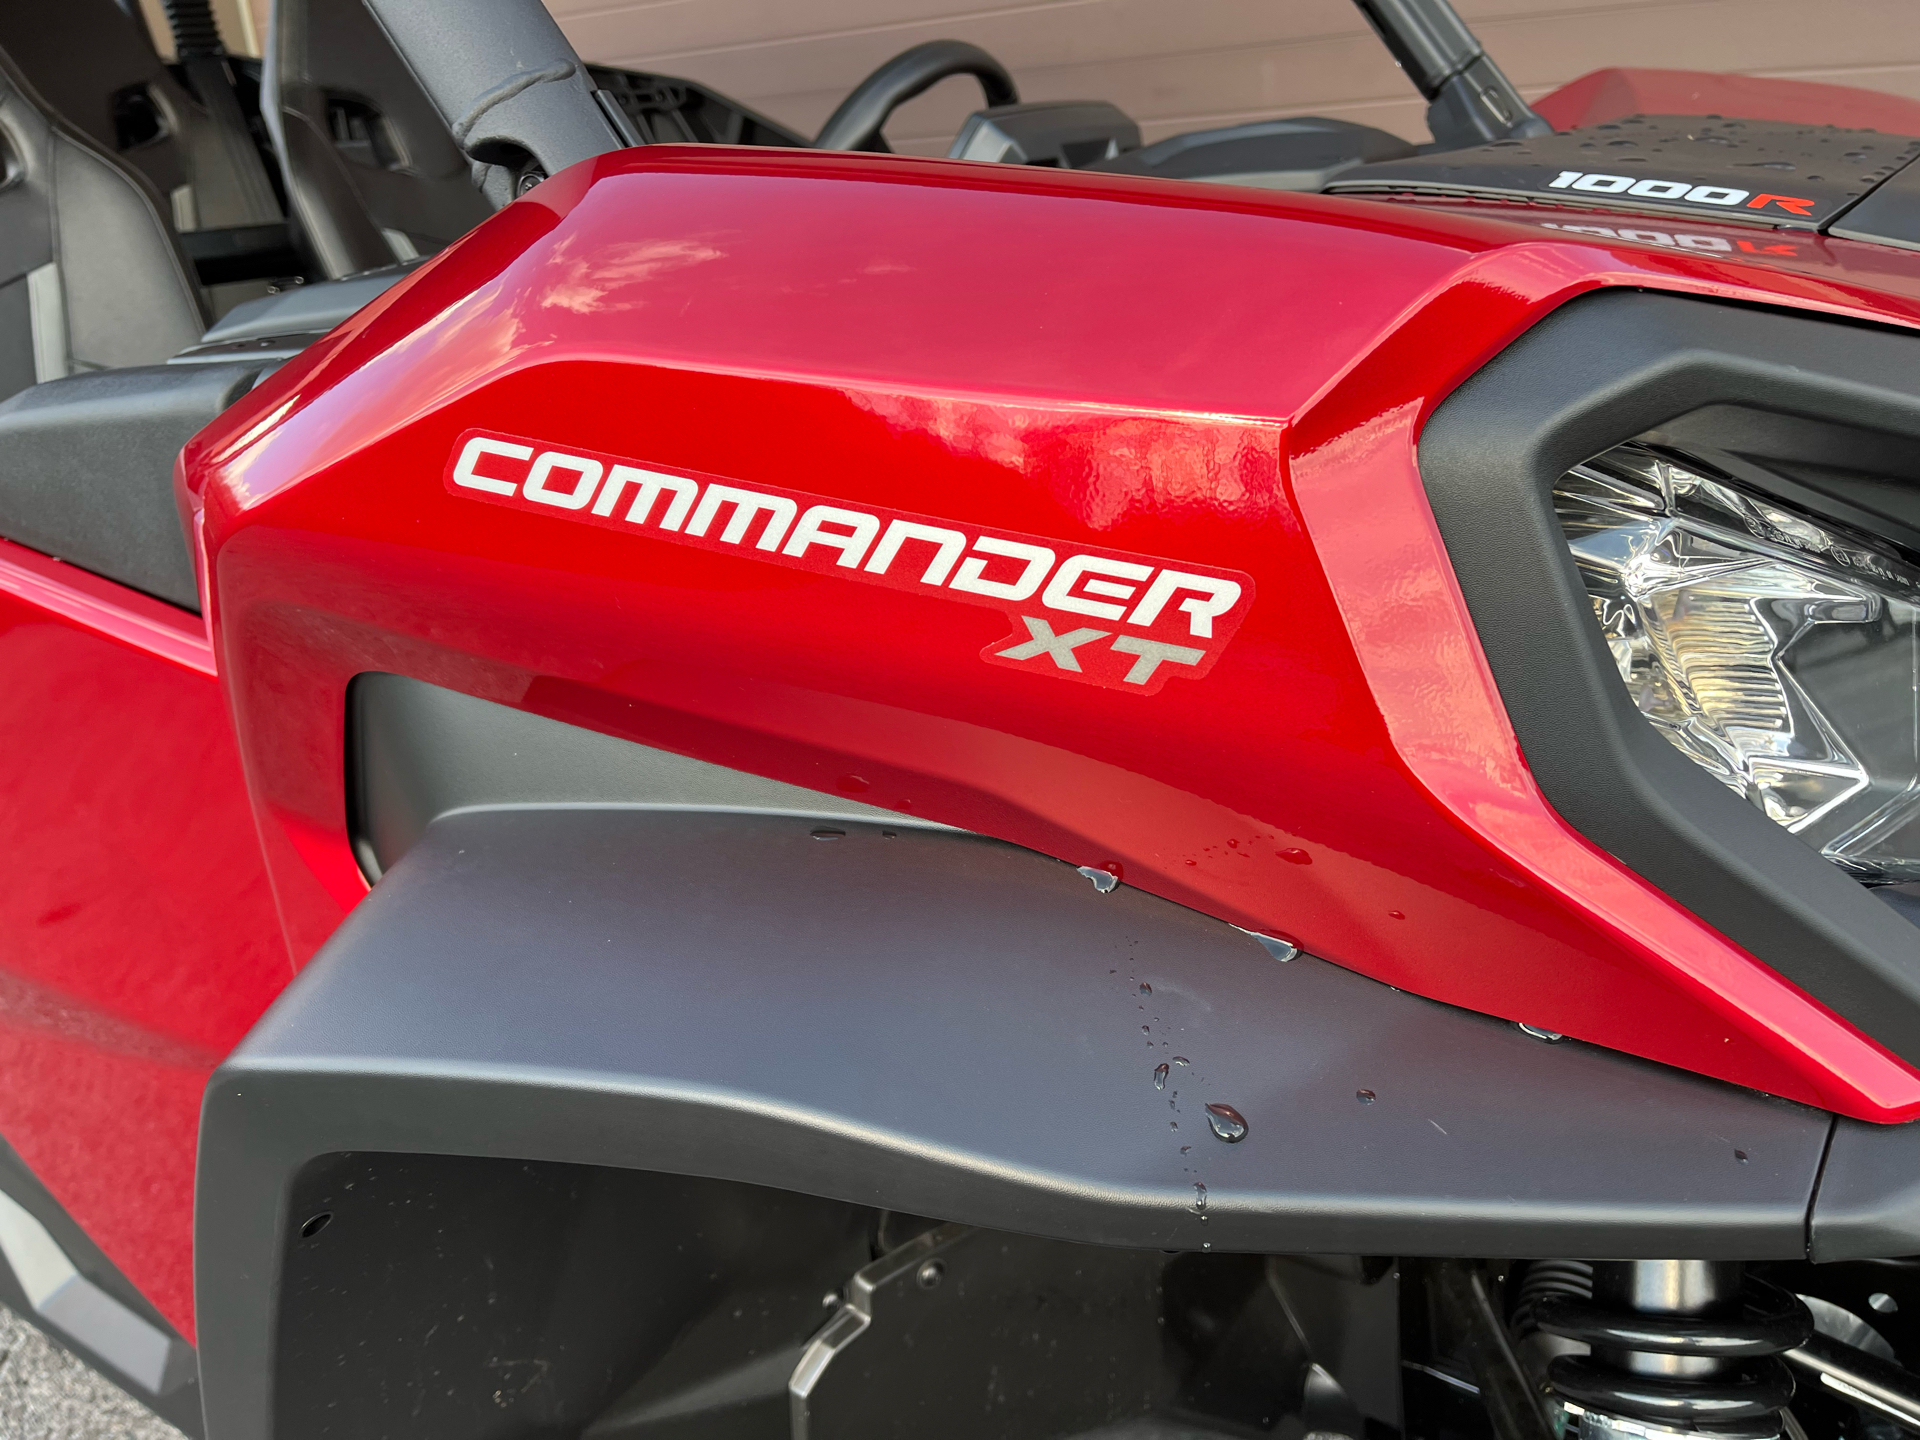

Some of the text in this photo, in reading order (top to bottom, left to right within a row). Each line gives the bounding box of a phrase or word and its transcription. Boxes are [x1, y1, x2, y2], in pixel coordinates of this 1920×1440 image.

[1548, 170, 1815, 216] 1000R
[453, 436, 1242, 639] COMMANDER
[995, 615, 1206, 685] XT
